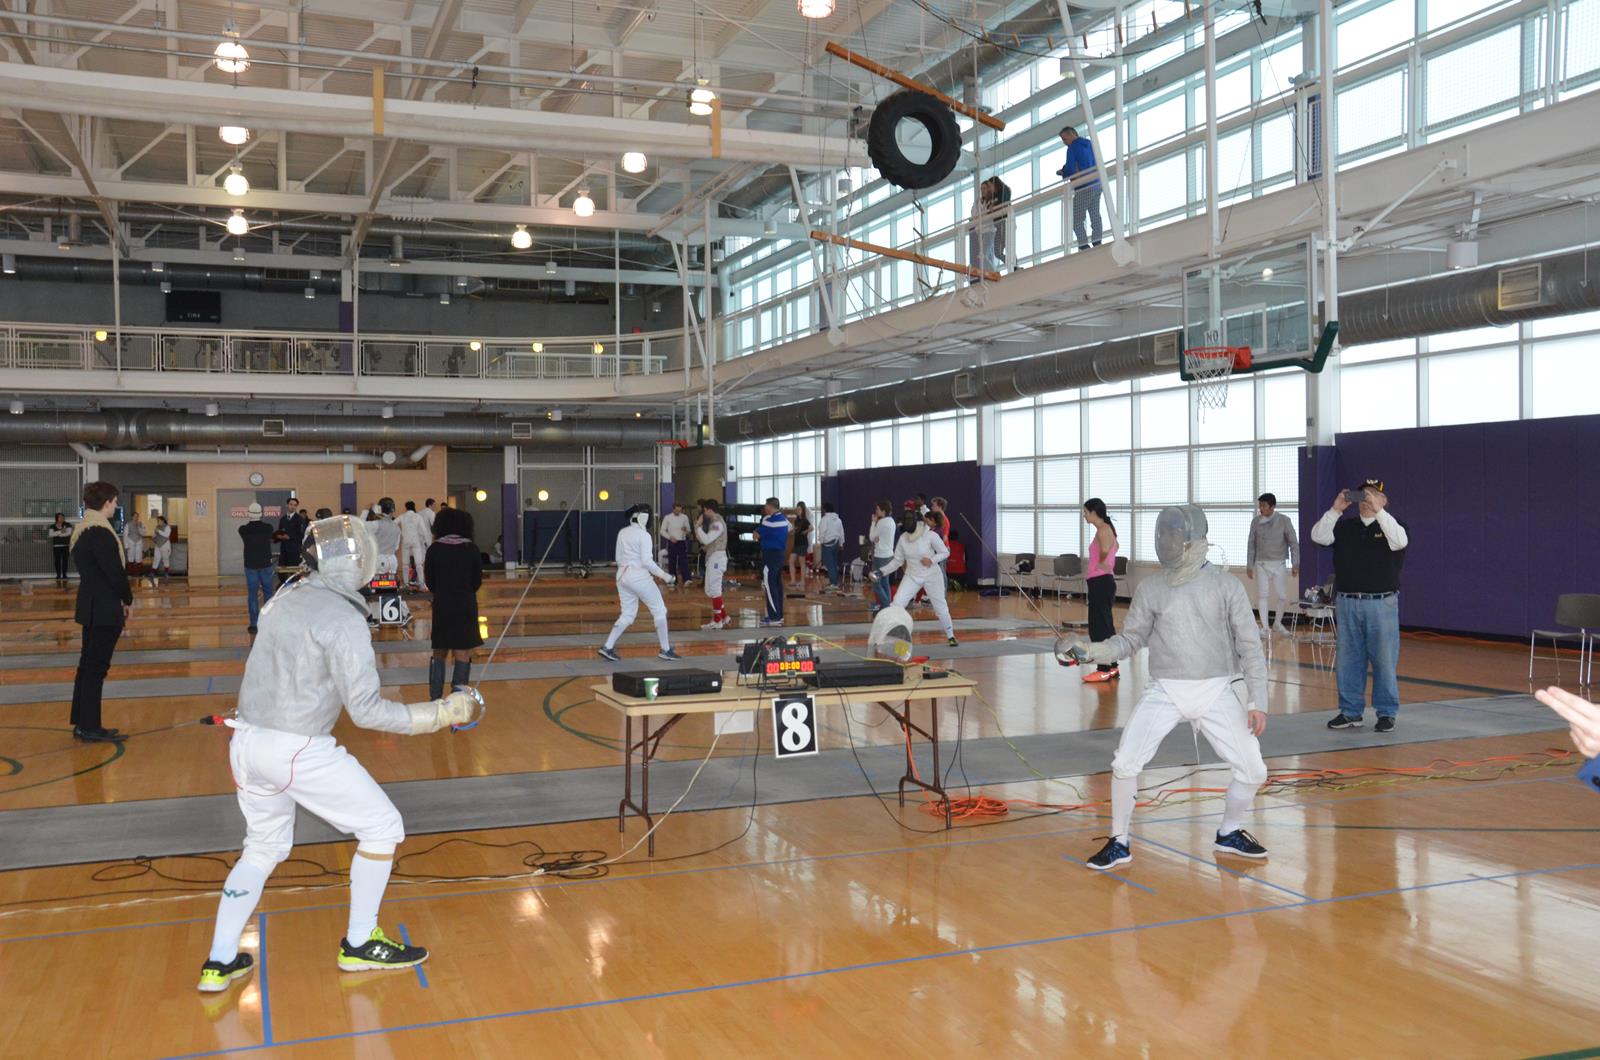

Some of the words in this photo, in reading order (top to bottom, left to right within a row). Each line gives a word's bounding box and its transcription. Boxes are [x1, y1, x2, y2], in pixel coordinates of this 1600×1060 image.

[1206, 330, 1219, 343] NO
[382, 598, 399, 621] 6
[766, 662, 780, 674] 00
[780, 661, 801, 671] 03:00
[801, 660, 814, 672] 00
[781, 702, 812, 752] 8
